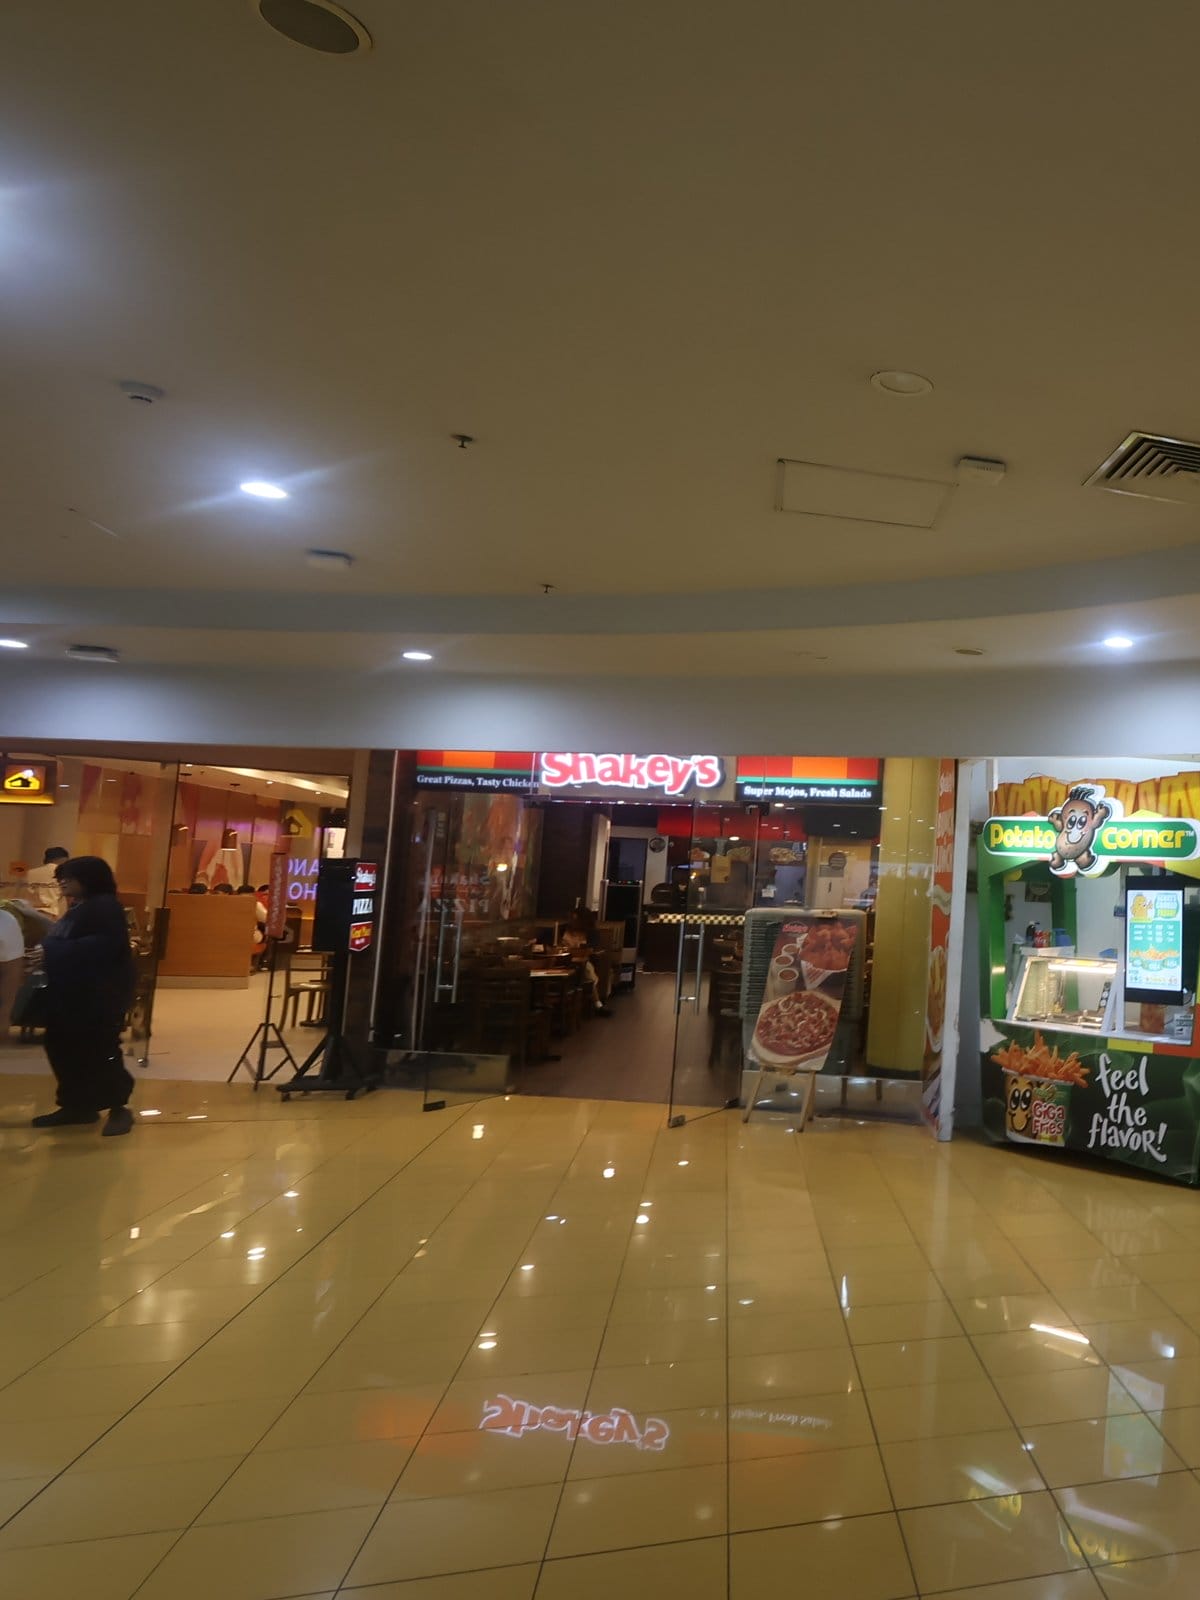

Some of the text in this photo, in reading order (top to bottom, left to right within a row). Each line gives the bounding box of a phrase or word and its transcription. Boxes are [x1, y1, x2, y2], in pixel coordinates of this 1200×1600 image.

[416, 775, 442, 784] Great
[444, 775, 475, 786] Pizzas,
[477, 777, 501, 788] Tasty
[541, 752, 721, 795] Shakey's
[743, 785, 872, 799] Super Mojos, Fresh Salads
[990, 822, 1057, 848] Potato
[1101, 826, 1185, 850] Corner
[352, 898, 374, 916] PIZZA
[1095, 1052, 1150, 1098] feel
[1107, 1092, 1147, 1127] the
